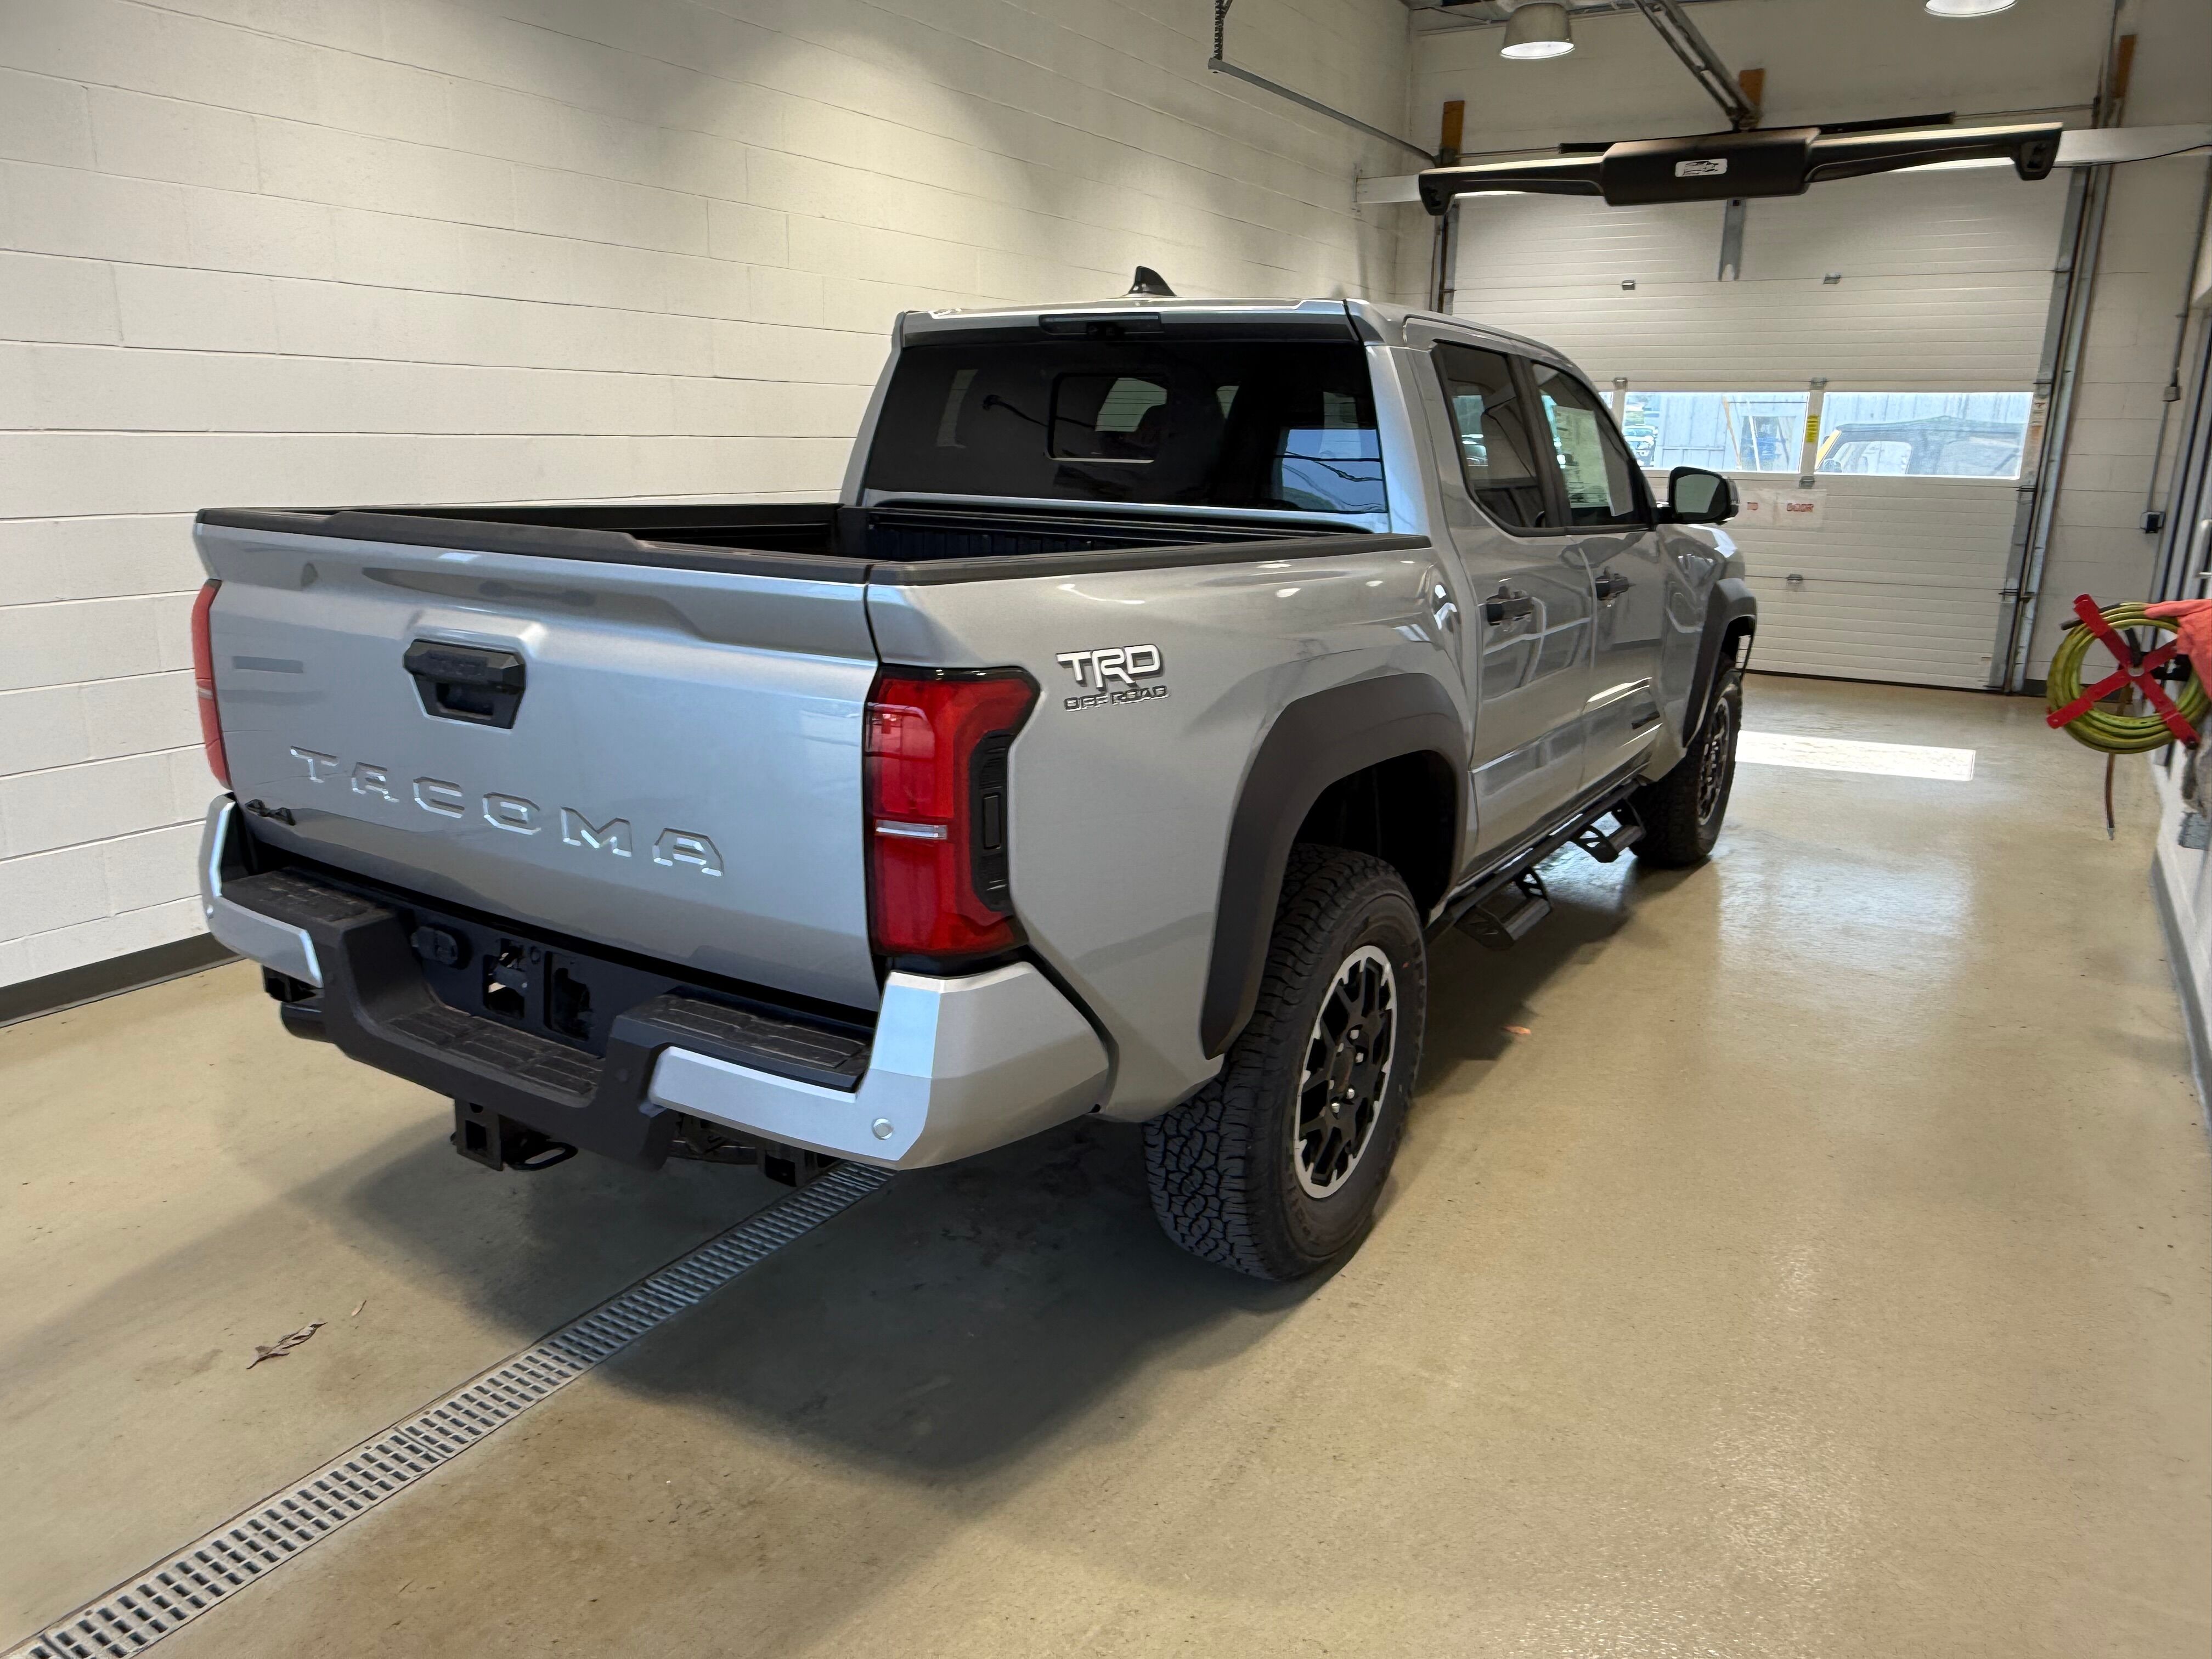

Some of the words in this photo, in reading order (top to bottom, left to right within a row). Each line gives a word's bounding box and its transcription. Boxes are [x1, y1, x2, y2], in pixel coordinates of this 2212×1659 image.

[1056, 644, 1161, 690] TRD
[1064, 694, 1109, 712] OFF
[1110, 685, 1170, 706] ROAD
[289, 745, 724, 877] TACOMA
